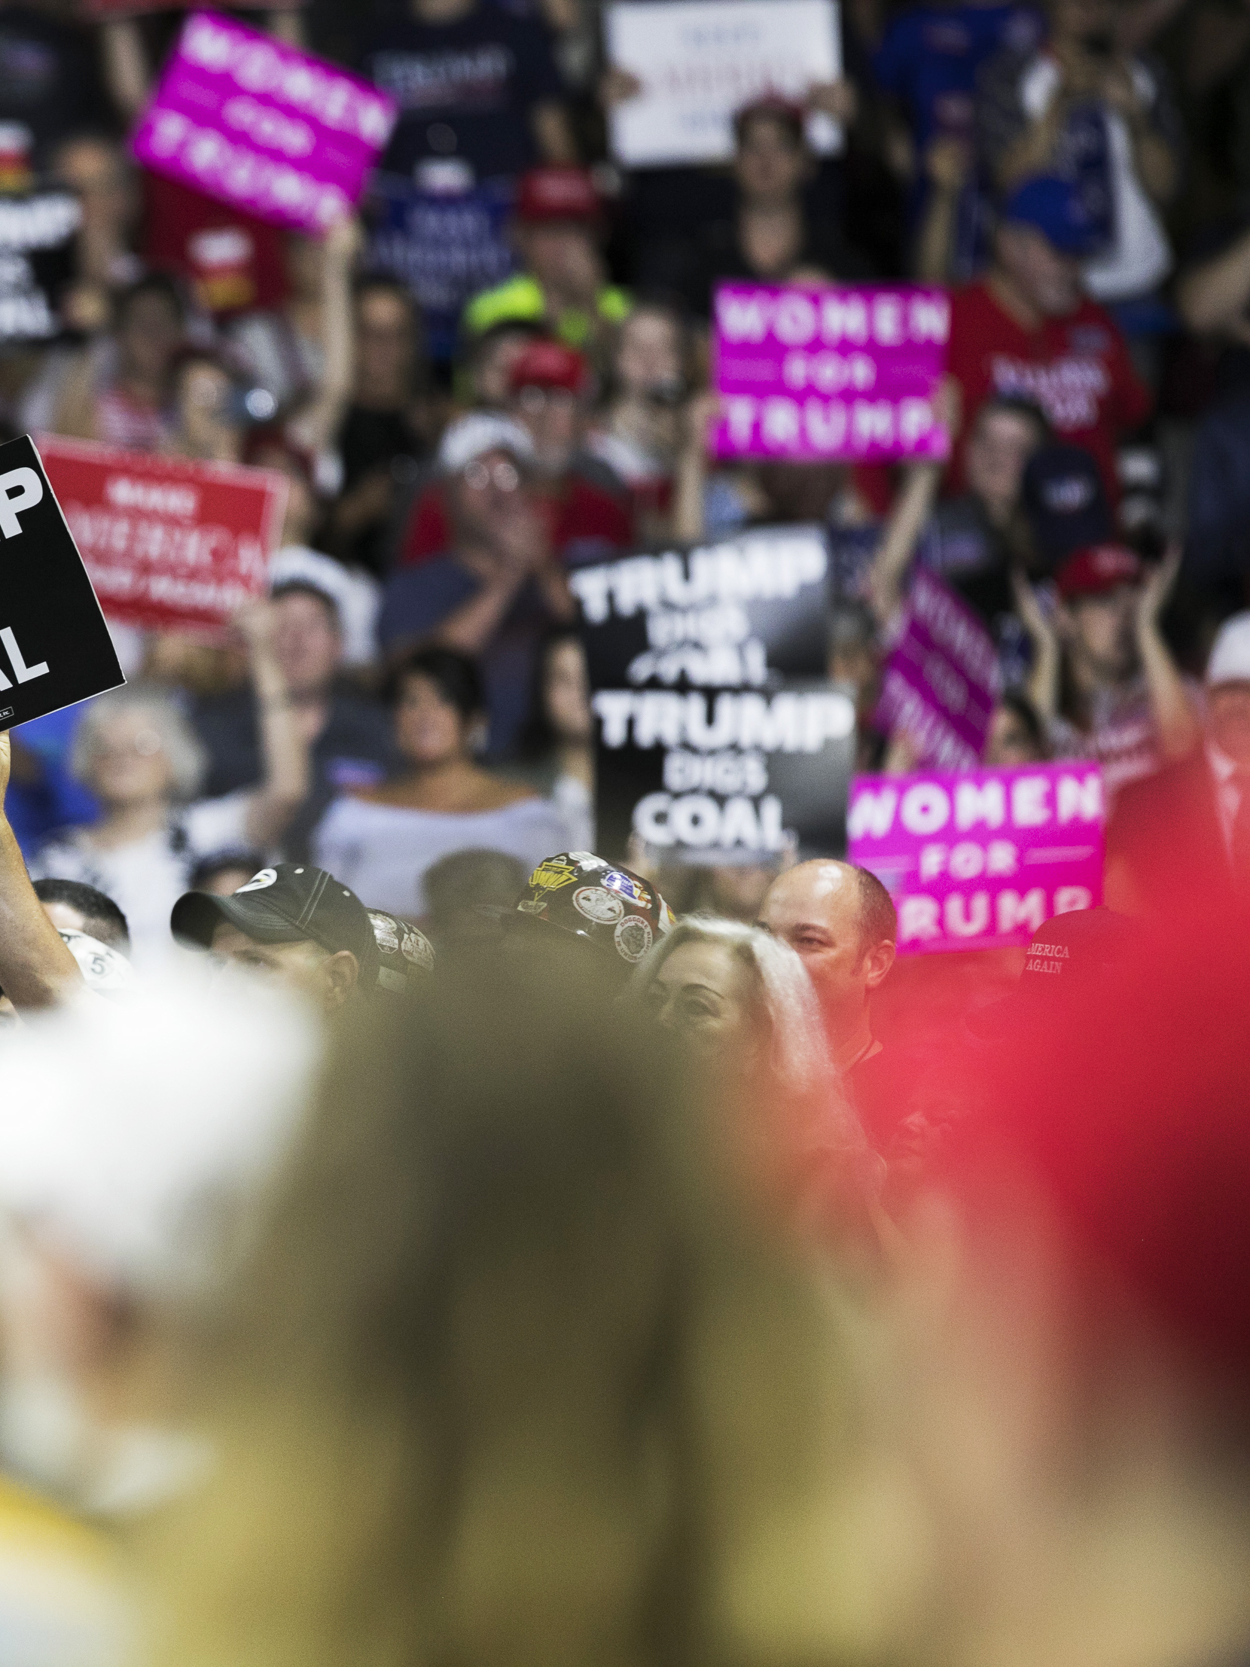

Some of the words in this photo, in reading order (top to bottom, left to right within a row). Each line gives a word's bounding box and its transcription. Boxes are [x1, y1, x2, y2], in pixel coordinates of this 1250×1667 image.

[178, 12, 396, 148] WOMEN
[150, 108, 350, 226] TRUMP
[714, 288, 952, 348] WOMEN
[782, 350, 878, 394] FOR
[722, 393, 934, 453] TRUMP
[567, 535, 828, 628] TRUMP
[592, 687, 856, 755] TRUMP
[662, 748, 769, 796] DIGS
[631, 790, 790, 850] COAL
[846, 770, 1103, 841] WOMEN
[918, 838, 1020, 884] FOR
[898, 884, 1094, 943] RUMP
[1026, 959, 1063, 974] AGAIN
